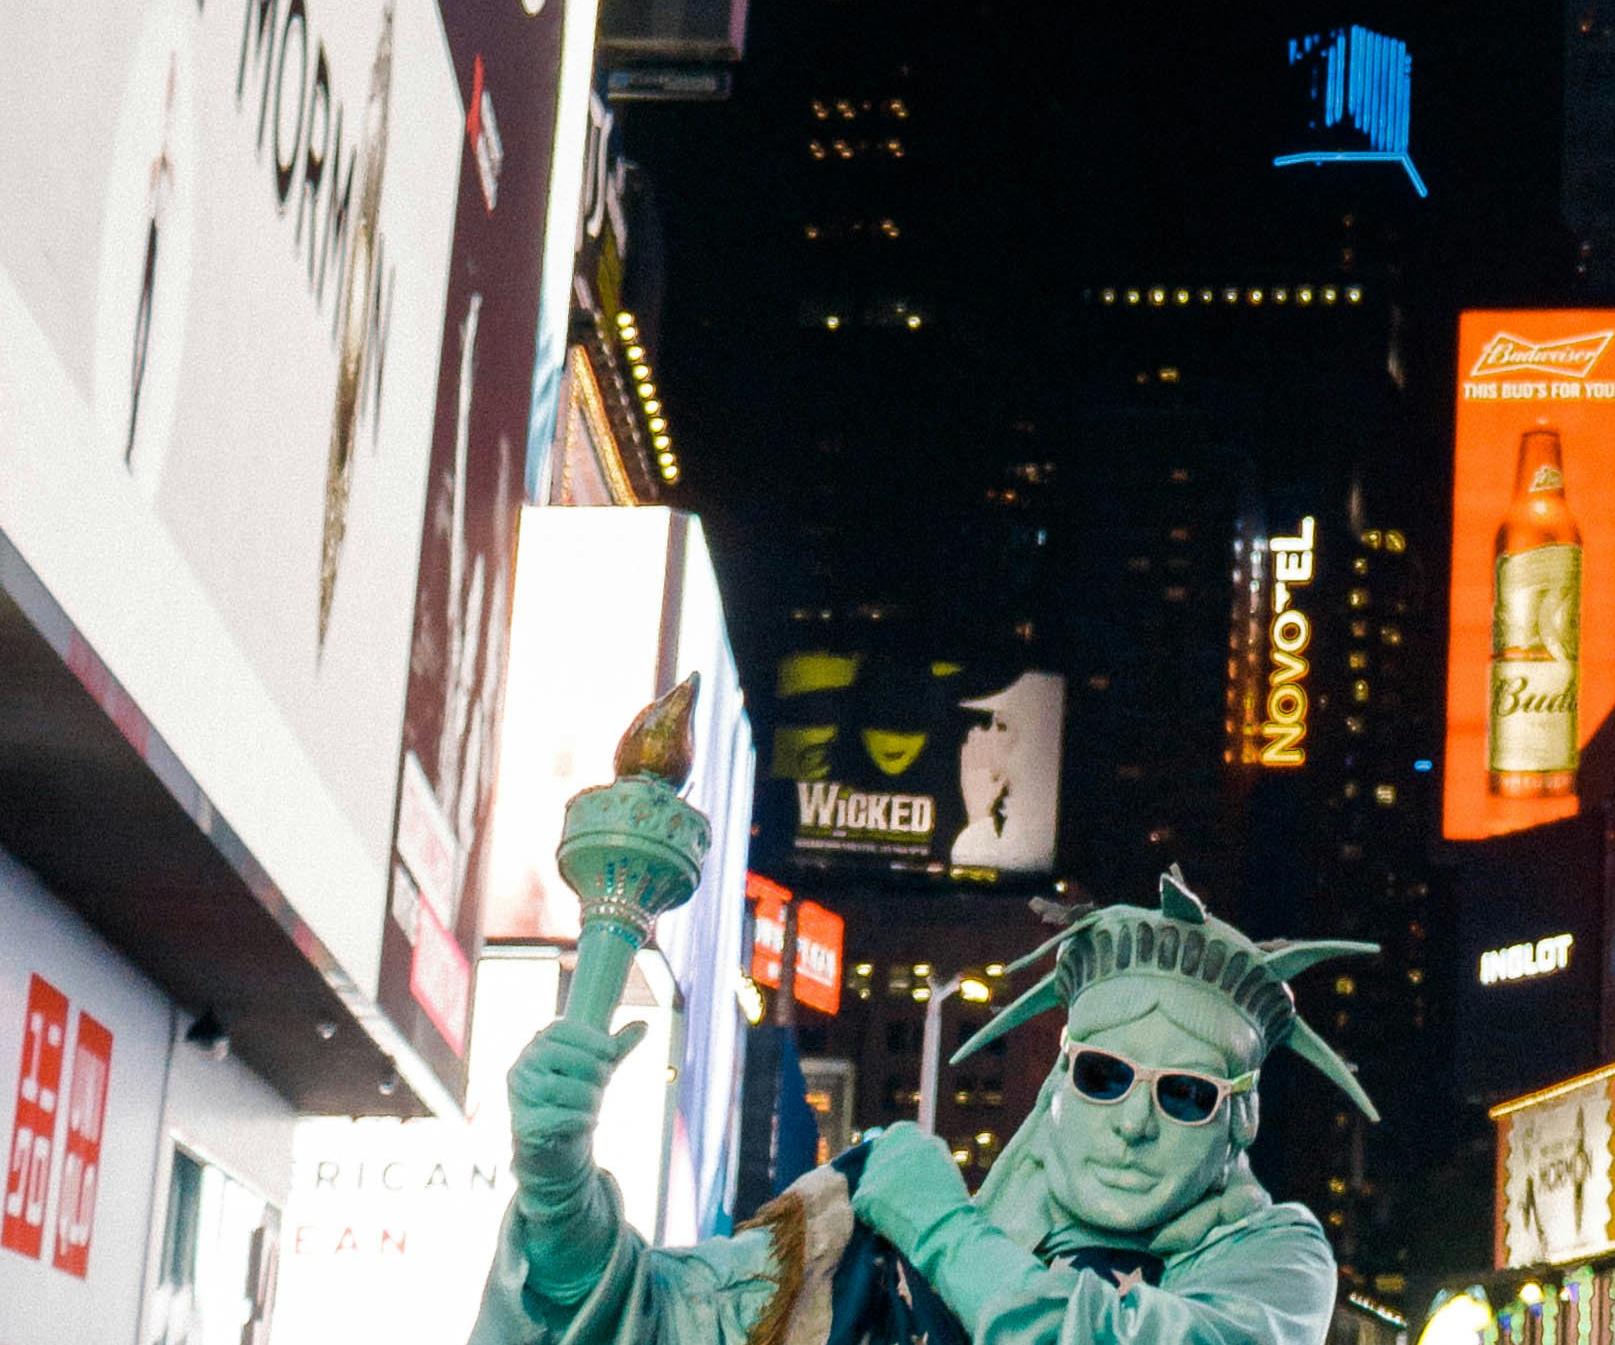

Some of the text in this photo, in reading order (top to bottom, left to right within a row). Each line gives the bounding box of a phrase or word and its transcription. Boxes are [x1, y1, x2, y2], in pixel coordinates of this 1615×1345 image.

[1485, 342, 1597, 366] Budweiser
[1463, 381, 1498, 400] THIS
[1501, 381, 1548, 400] BUD'S
[1551, 381, 1580, 400] FOR
[1261, 515, 1316, 767] NOVOTEL
[290, 1160, 498, 1191] RICAN
